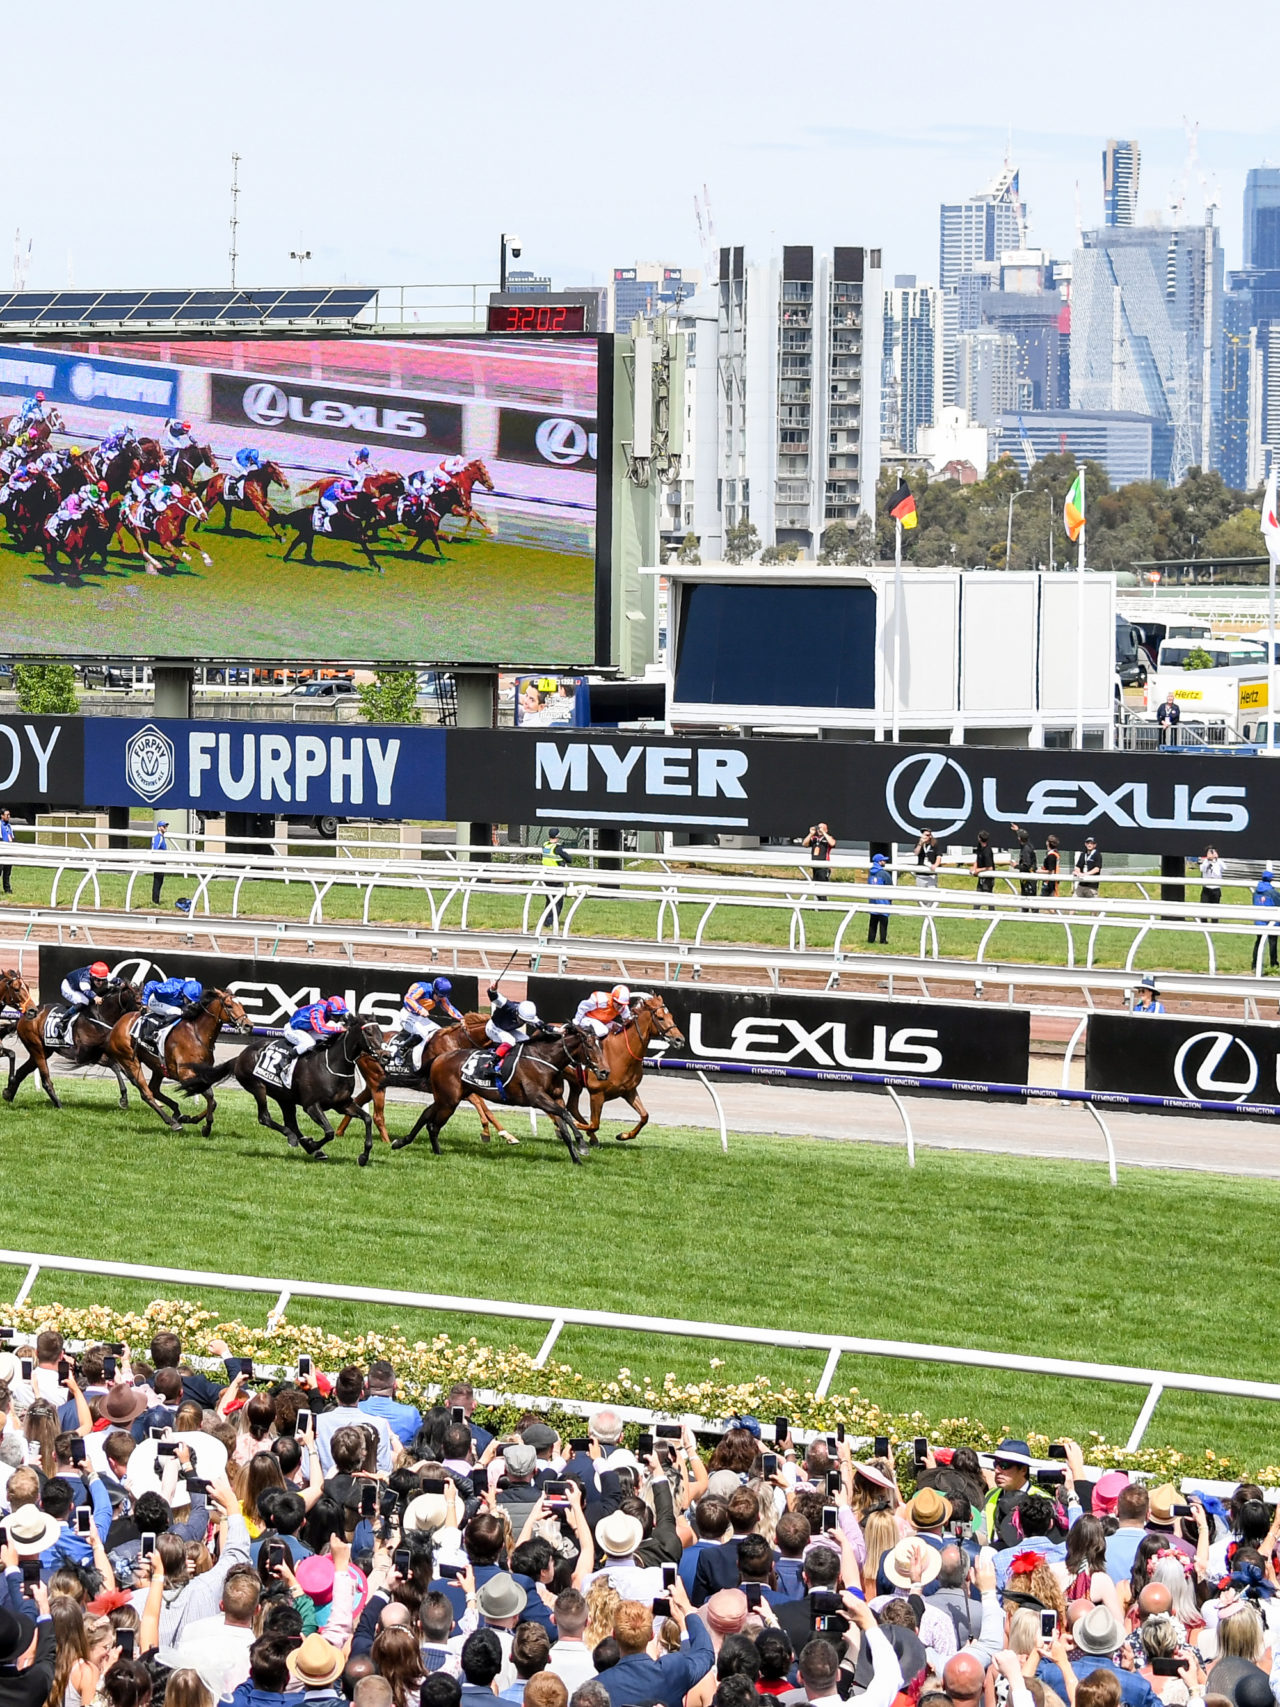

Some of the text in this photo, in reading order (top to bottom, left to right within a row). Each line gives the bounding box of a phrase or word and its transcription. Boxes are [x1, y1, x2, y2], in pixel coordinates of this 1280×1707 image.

[506, 307, 567, 331] 3:20.2
[288, 396, 426, 438] LEXUS
[1175, 689, 1200, 700] Hertz
[1240, 689, 1260, 705] Hertz
[134, 738, 166, 758] FURPHY
[189, 731, 400, 806] FURPHY
[536, 741, 749, 799] MYER
[982, 777, 1250, 832] LEXUS
[183, 976, 402, 1032] EXUS
[689, 1012, 943, 1073] LEXUS
[261, 1049, 283, 1075] 12
[686, 1062, 721, 1072] FLEMINGTON
[751, 1067, 787, 1077] FLEMINGTON
[817, 1072, 854, 1082] FLEMINGTON
[883, 1077, 920, 1087] FLEMINGTON
[951, 1082, 989, 1093] FLEMINGTON
[1021, 1087, 1059, 1098] FLEMINGTON
[1091, 1093, 1130, 1104] FLEMINGTON
[1163, 1099, 1202, 1110] FLEMINGTON
[1236, 1105, 1276, 1116] FLEMINGTON
